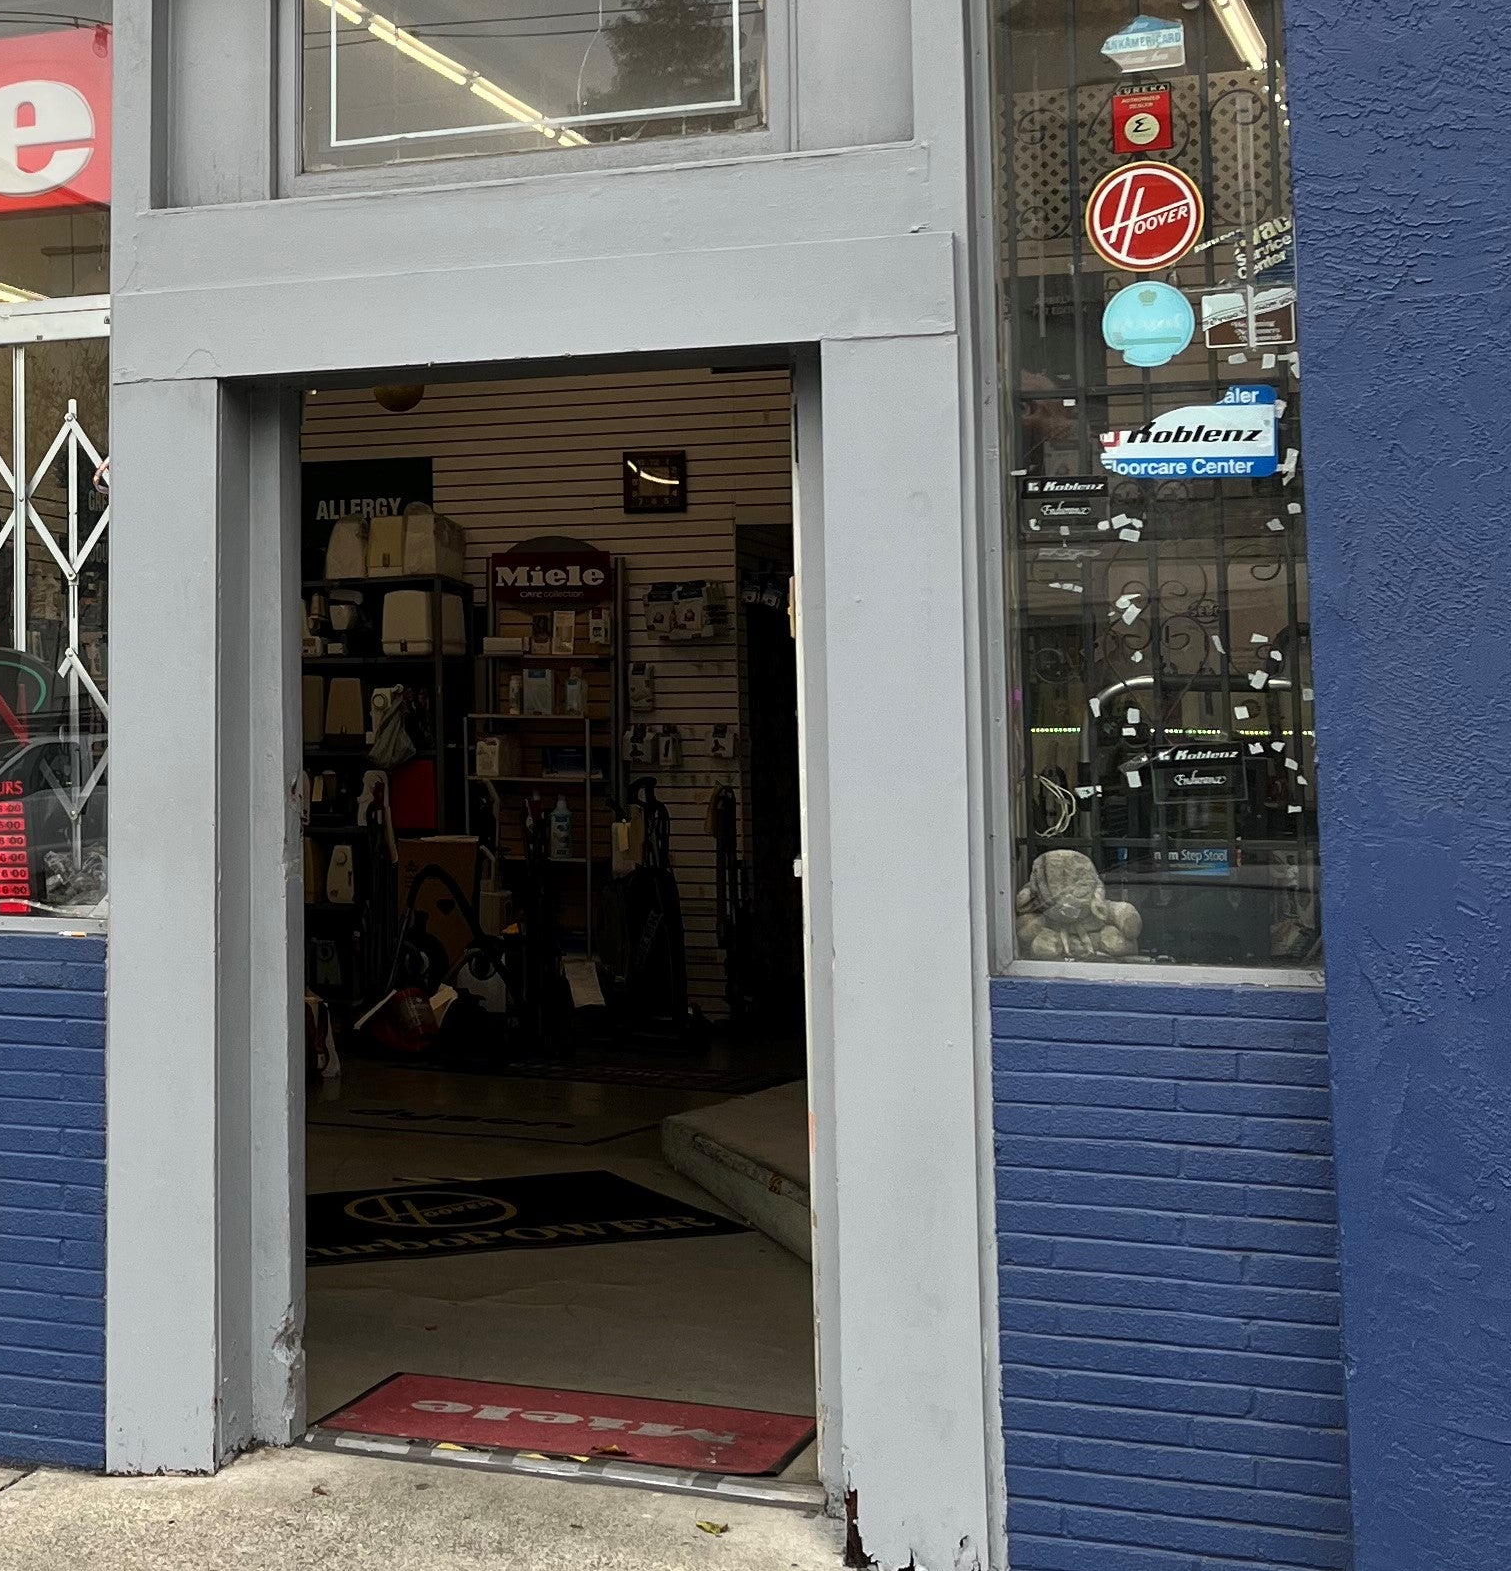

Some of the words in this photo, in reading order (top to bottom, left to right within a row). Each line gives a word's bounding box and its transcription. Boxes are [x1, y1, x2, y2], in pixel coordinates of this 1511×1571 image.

[1217, 387, 1259, 405] aler
[1127, 422, 1263, 444] Koblenz
[1191, 458, 1255, 474] Center
[1043, 481, 1105, 492] Koblenz
[315, 497, 402, 521] ALLERGY
[495, 565, 605, 587] Miele
[1174, 750, 1239, 761] Koblenz
[1180, 849, 1202, 864] Step
[1203, 849, 1228, 862] Stool
